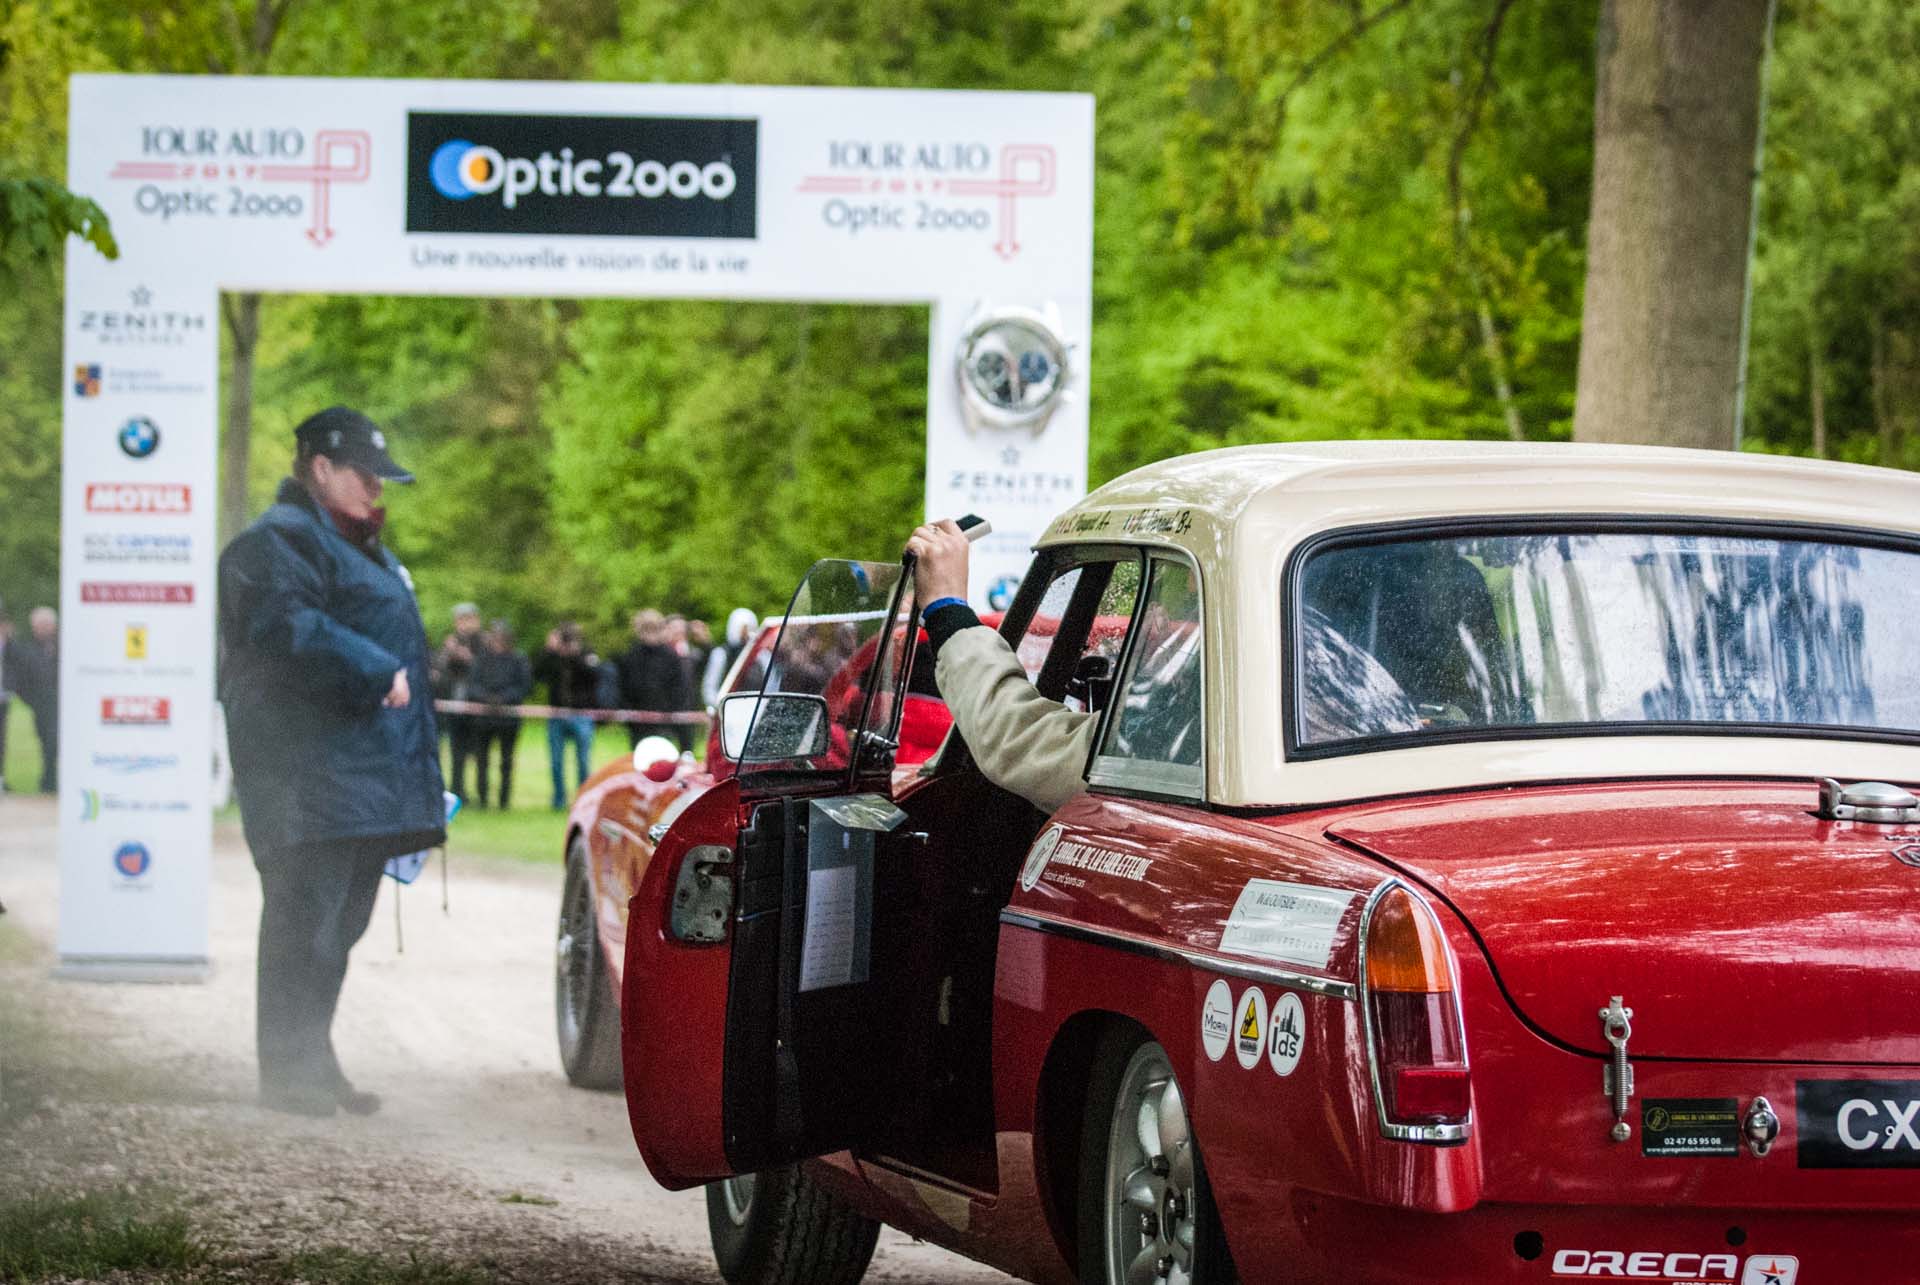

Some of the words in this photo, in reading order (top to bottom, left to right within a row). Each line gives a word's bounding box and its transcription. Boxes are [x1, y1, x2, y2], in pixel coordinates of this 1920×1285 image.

[141, 126, 217, 155] TOUR
[227, 127, 304, 157] AUTO
[828, 139, 905, 169] TOUR
[912, 141, 991, 171] AUTO
[458, 145, 602, 209] Optic
[606, 151, 737, 200] 2000
[134, 184, 217, 219] Optic
[228, 187, 304, 217] 2000
[822, 198, 905, 234] Optic
[915, 201, 991, 231] 2000
[412, 247, 458, 269] Une
[467, 247, 568, 270] nouvelle
[576, 249, 645, 271] vision
[652, 249, 680, 271] de
[689, 250, 709, 272] la
[716, 252, 749, 273] vie
[80, 310, 205, 332] ZENITH
[950, 471, 1074, 492] ZENITH
[90, 486, 188, 511] MOTUL
[1271, 1015, 1298, 1058] ids
[1836, 1099, 1920, 1150] CX
[1664, 1137, 1675, 1145] 02
[1676, 1137, 1686, 1145] 47
[1687, 1137, 1698, 1145] 65
[1699, 1137, 1710, 1145] 95
[1552, 1249, 1738, 1279] ORECA
